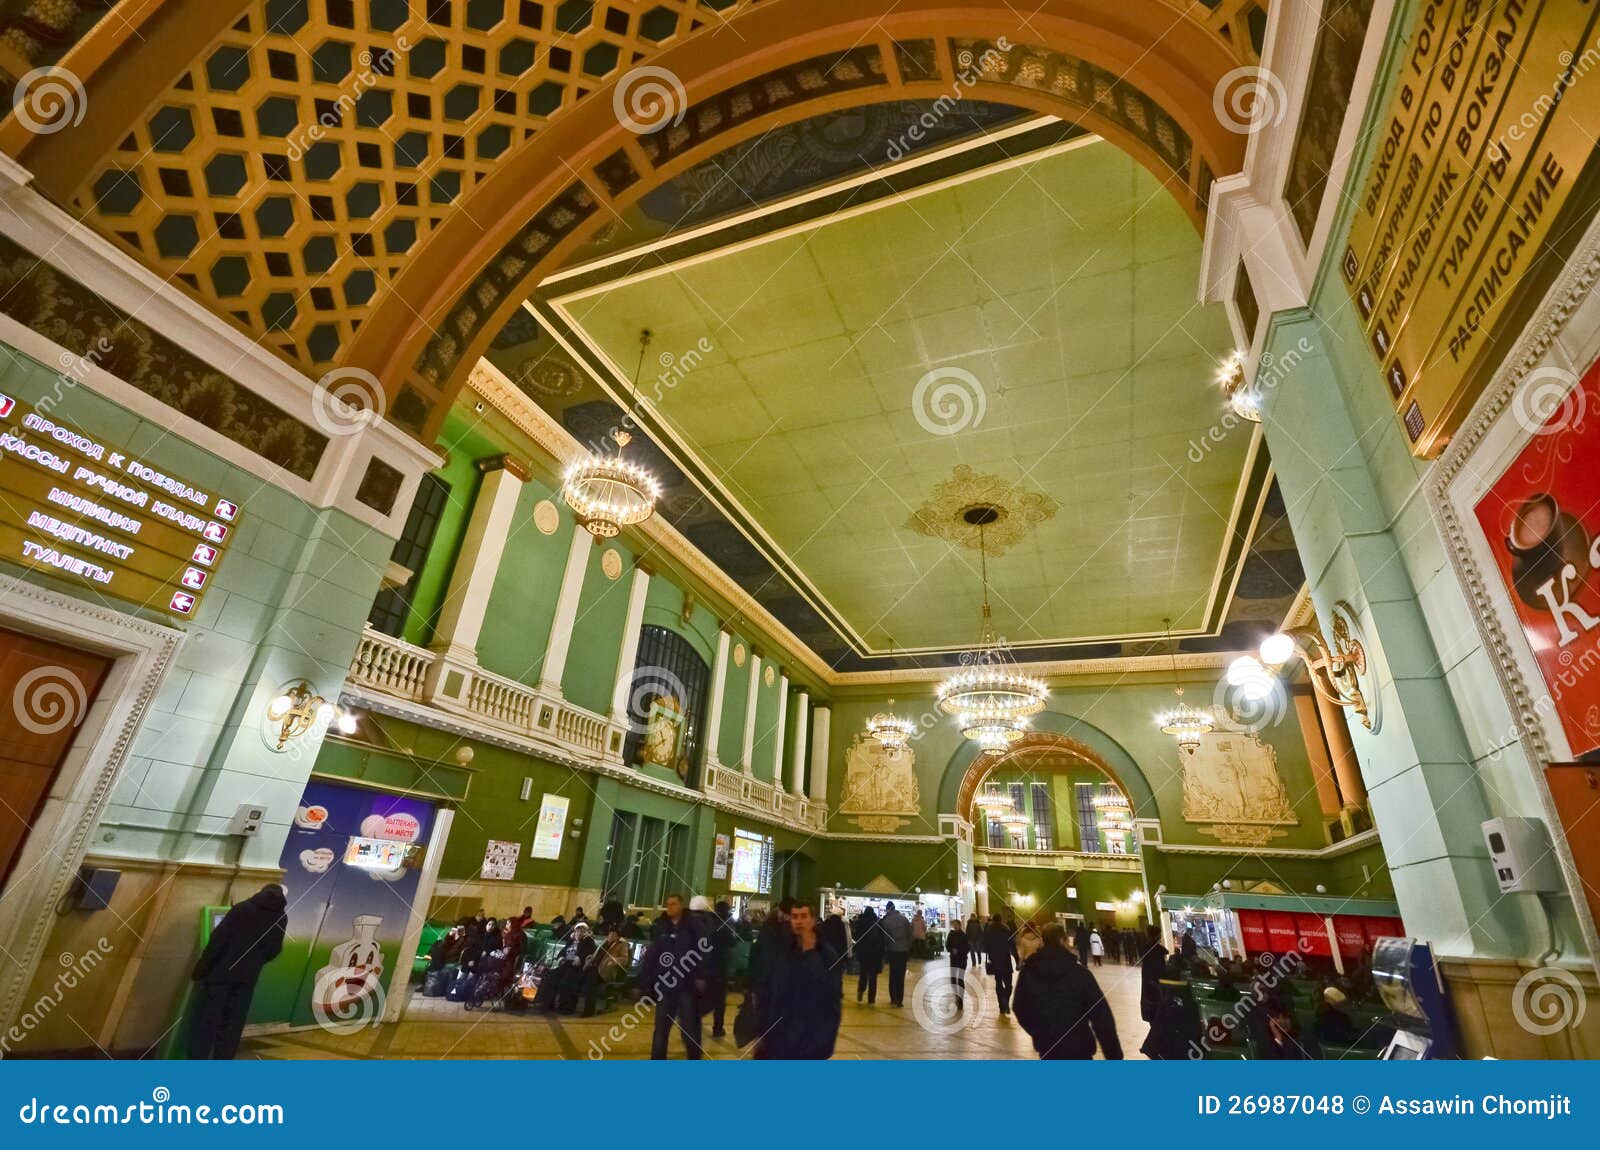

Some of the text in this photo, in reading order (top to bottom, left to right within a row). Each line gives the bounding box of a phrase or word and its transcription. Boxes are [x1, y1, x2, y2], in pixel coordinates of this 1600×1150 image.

[1366, 0, 1444, 218] ВЫХОД В ГОР
[1386, 0, 1527, 324] НАЧАЛЬНИК ВОКЗАЛ
[1370, 152, 1424, 294] ДЕЖУРНЫЙ
[1421, 101, 1442, 149] ПО
[1438, 142, 1512, 289] ТУАЛЕТЫ
[1448, 152, 1564, 363] РАСПИСАНИЕ
[0, 433, 205, 533] КАССЫ РУЧНОЙ КЛАДИ
[25, 413, 208, 506] ПРОХОД К ПОЕЗДАМ
[48, 487, 141, 534] МИЛИЦИЯ
[23, 541, 113, 584] ТУАЛЕТЫ
[28, 511, 134, 560] МЕДПУНКТ
